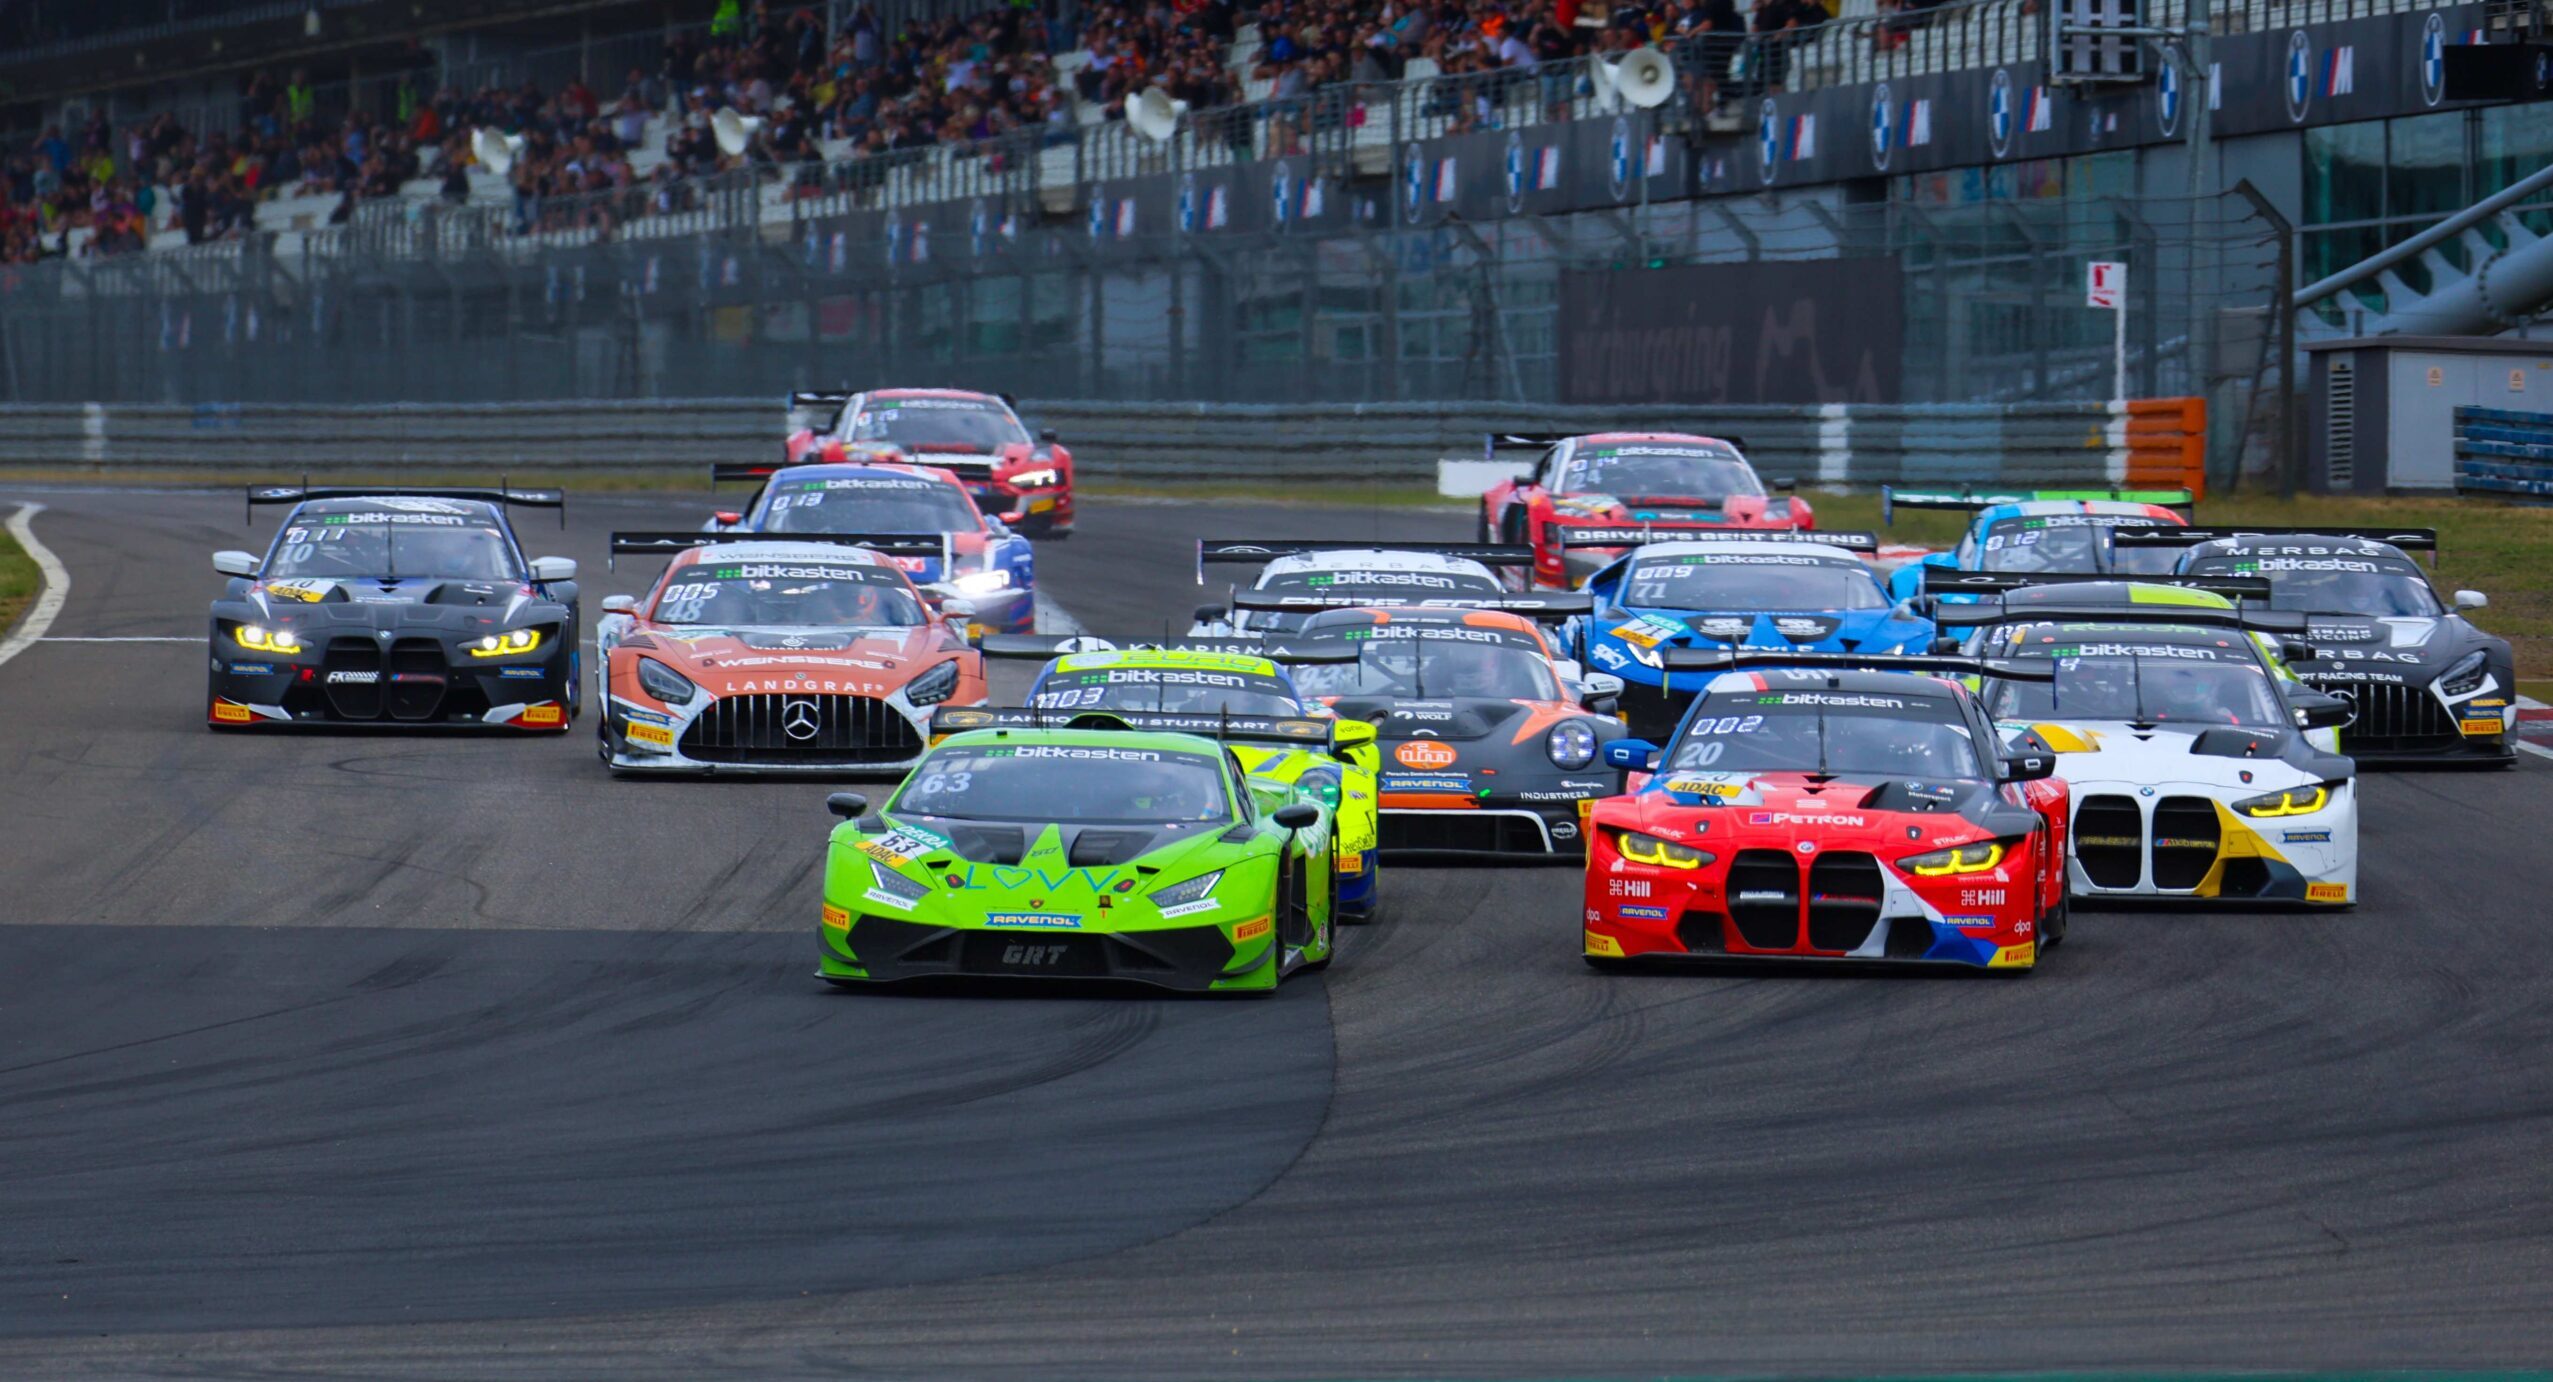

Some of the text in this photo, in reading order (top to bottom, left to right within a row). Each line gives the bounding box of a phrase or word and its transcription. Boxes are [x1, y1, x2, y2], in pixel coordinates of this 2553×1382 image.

[1616, 447, 1714, 457] bitkasten
[825, 479, 930, 490] bitkasten
[348, 513, 464, 525] bitkasten
[2045, 517, 2155, 527] bitkasten
[1700, 532, 1765, 542] BEST
[1772, 533, 1868, 545] FRIEND
[277, 544, 314, 564] 10
[2226, 546, 2380, 556] MERBAG
[1704, 555, 1820, 566] bitkasten
[2258, 558, 2379, 573] bitkasten
[741, 564, 864, 581] bitkasten
[1333, 572, 1456, 589] bitkasten
[662, 582, 721, 603] 005
[1635, 582, 1667, 599] 71
[665, 599, 705, 623] 48
[1372, 626, 1502, 643] bitkasten
[2079, 645, 2217, 660] bitkasten
[2315, 650, 2420, 664] RBAG
[718, 655, 884, 670] WEINSBERG
[1108, 670, 1245, 687] bitkasten
[2318, 672, 2367, 681] RACING
[2369, 673, 2403, 682] TEAM
[1782, 694, 1903, 708] bitkasten
[1691, 715, 1764, 735] 002
[1014, 746, 1160, 761] bitkasten
[1675, 742, 1724, 769] 20
[922, 772, 972, 794] 63
[1391, 780, 1464, 788] RAVENOL
[1674, 782, 1726, 795] ADAC
[1773, 812, 1865, 826] PETRON
[881, 834, 921, 854] 63
[864, 844, 899, 863] ADAC
[1625, 880, 1651, 898] Hill
[1978, 889, 2005, 906] Hill
[1622, 907, 1663, 918] RAVENOL
[993, 916, 1075, 926] RAVENOL
[1946, 917, 1991, 925] RAVENOL
[2013, 919, 2031, 936] dpa
